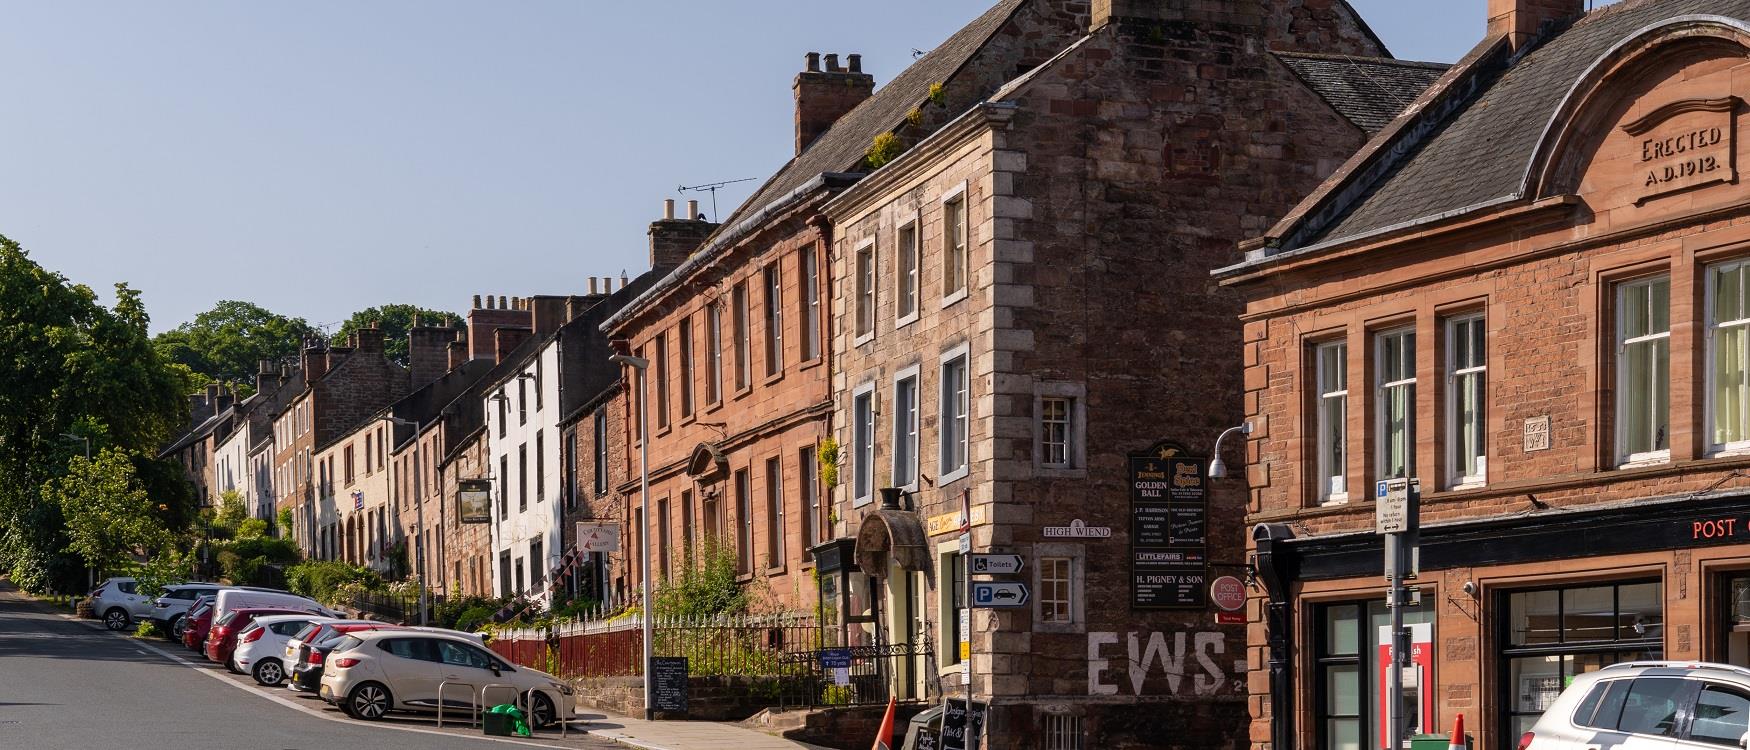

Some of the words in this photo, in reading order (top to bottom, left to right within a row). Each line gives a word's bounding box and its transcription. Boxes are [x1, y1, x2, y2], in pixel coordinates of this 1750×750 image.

[1641, 127, 1722, 163] ERECTED
[1135, 481, 1168, 489] GOLDEN
[1141, 489, 1162, 498] BALL
[1045, 527, 1072, 536] HIGH
[1075, 527, 1110, 536] WIEND
[1693, 518, 1737, 539] POST
[1136, 575, 1145, 584] H.
[1147, 575, 1177, 584] PIGNEY
[1178, 575, 1185, 584] &
[1186, 575, 1203, 584] SON
[1221, 583, 1238, 592] POST
[1217, 592, 1243, 601] OFFICE
